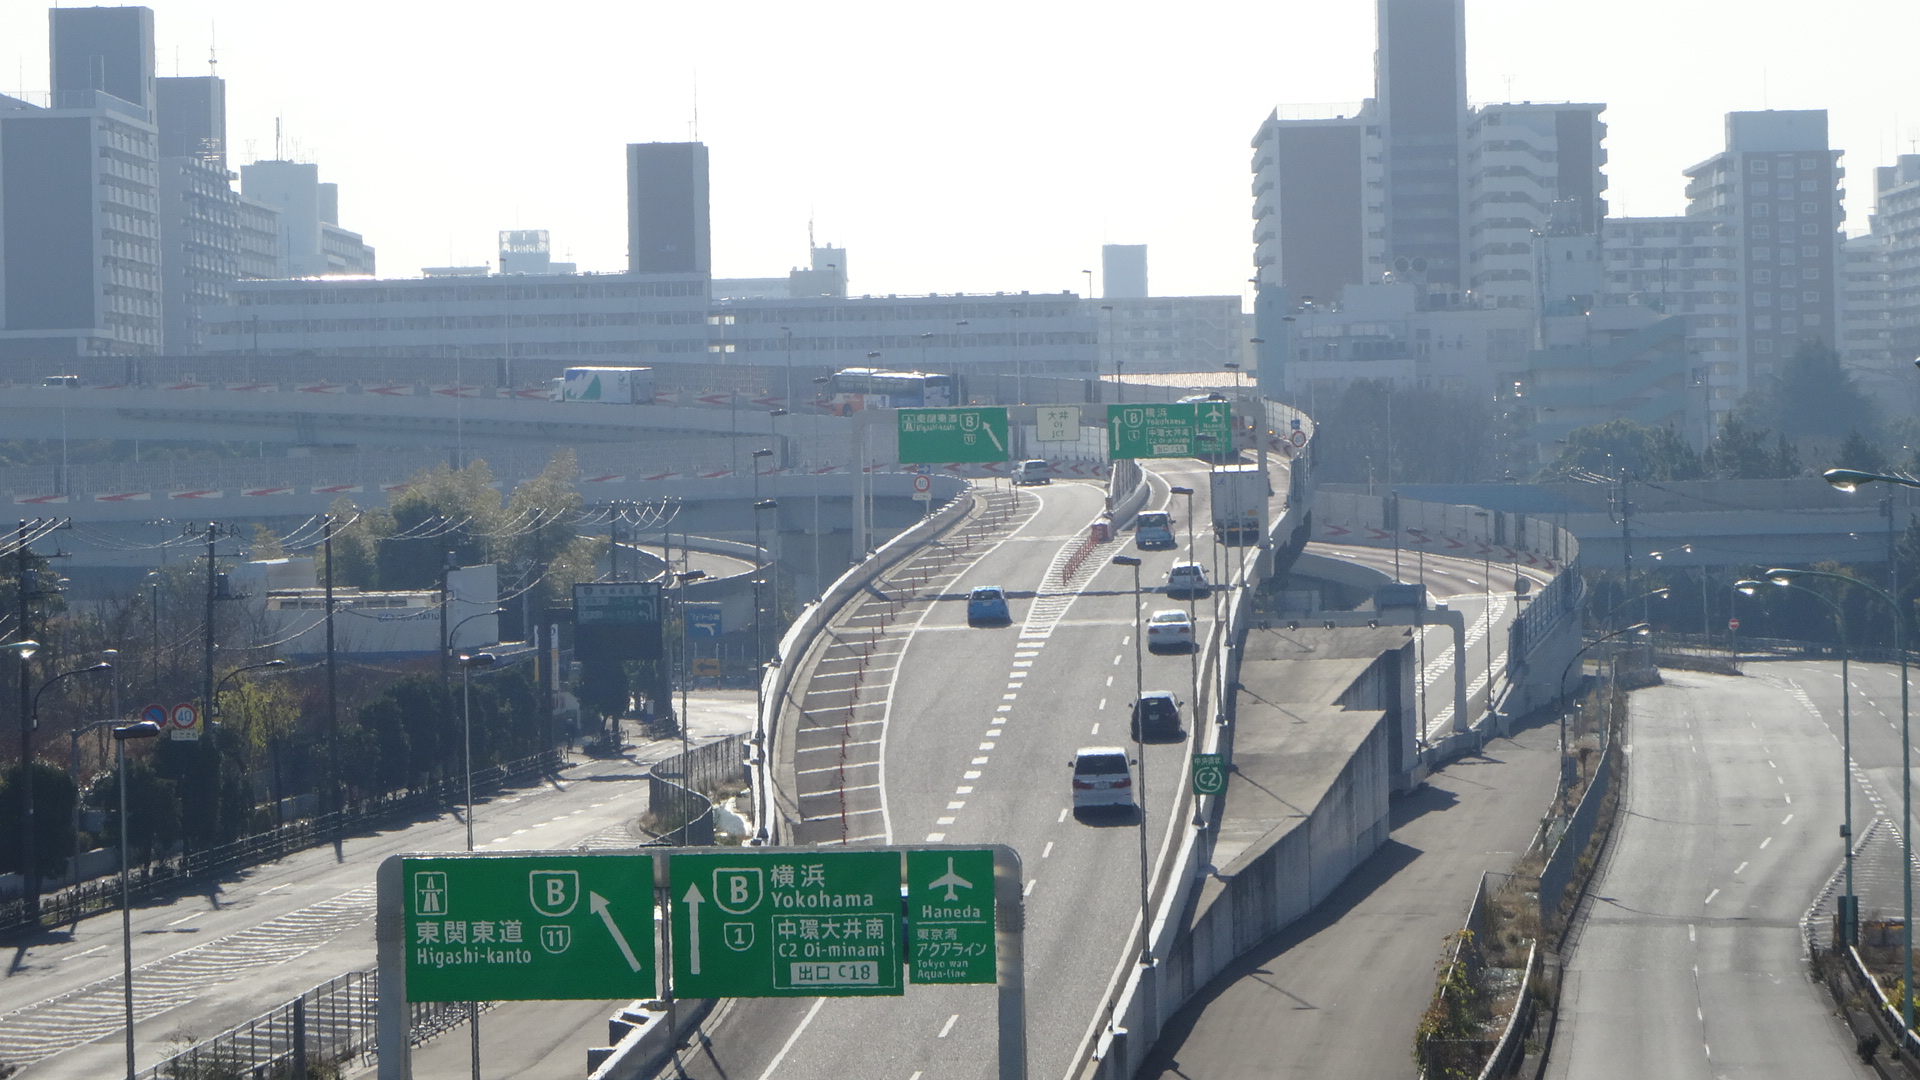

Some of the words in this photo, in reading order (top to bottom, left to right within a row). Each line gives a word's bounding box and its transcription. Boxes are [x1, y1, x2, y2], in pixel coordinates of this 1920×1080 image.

[1048, 411, 1069, 421] 大井
[1130, 412, 1138, 424] B
[1145, 408, 1168, 418] 横浜
[965, 416, 974, 427] B
[178, 710, 192, 722] 40
[1199, 772, 1217, 787] C2
[771, 864, 825, 888] 横浜
[546, 878, 566, 906] B
[730, 876, 749, 904] B
[771, 890, 874, 908] Yokohama
[922, 905, 981, 918] Haneda
[416, 919, 523, 944] 東関東道
[733, 927, 745, 945] 1
[778, 917, 885, 940] 中環大井南
[917, 928, 958, 940] 東京湾
[546, 930, 564, 947] 11
[417, 947, 532, 968] Higashi-kanto
[778, 942, 798, 958] C2
[804, 941, 885, 957] Oi-minami
[917, 942, 987, 957] アクアライン
[798, 965, 830, 981] 出口
[838, 964, 871, 980] C18
[917, 959, 945, 970] Tokyo
[949, 960, 969, 968] wan
[917, 969, 967, 980] Aqua-line
